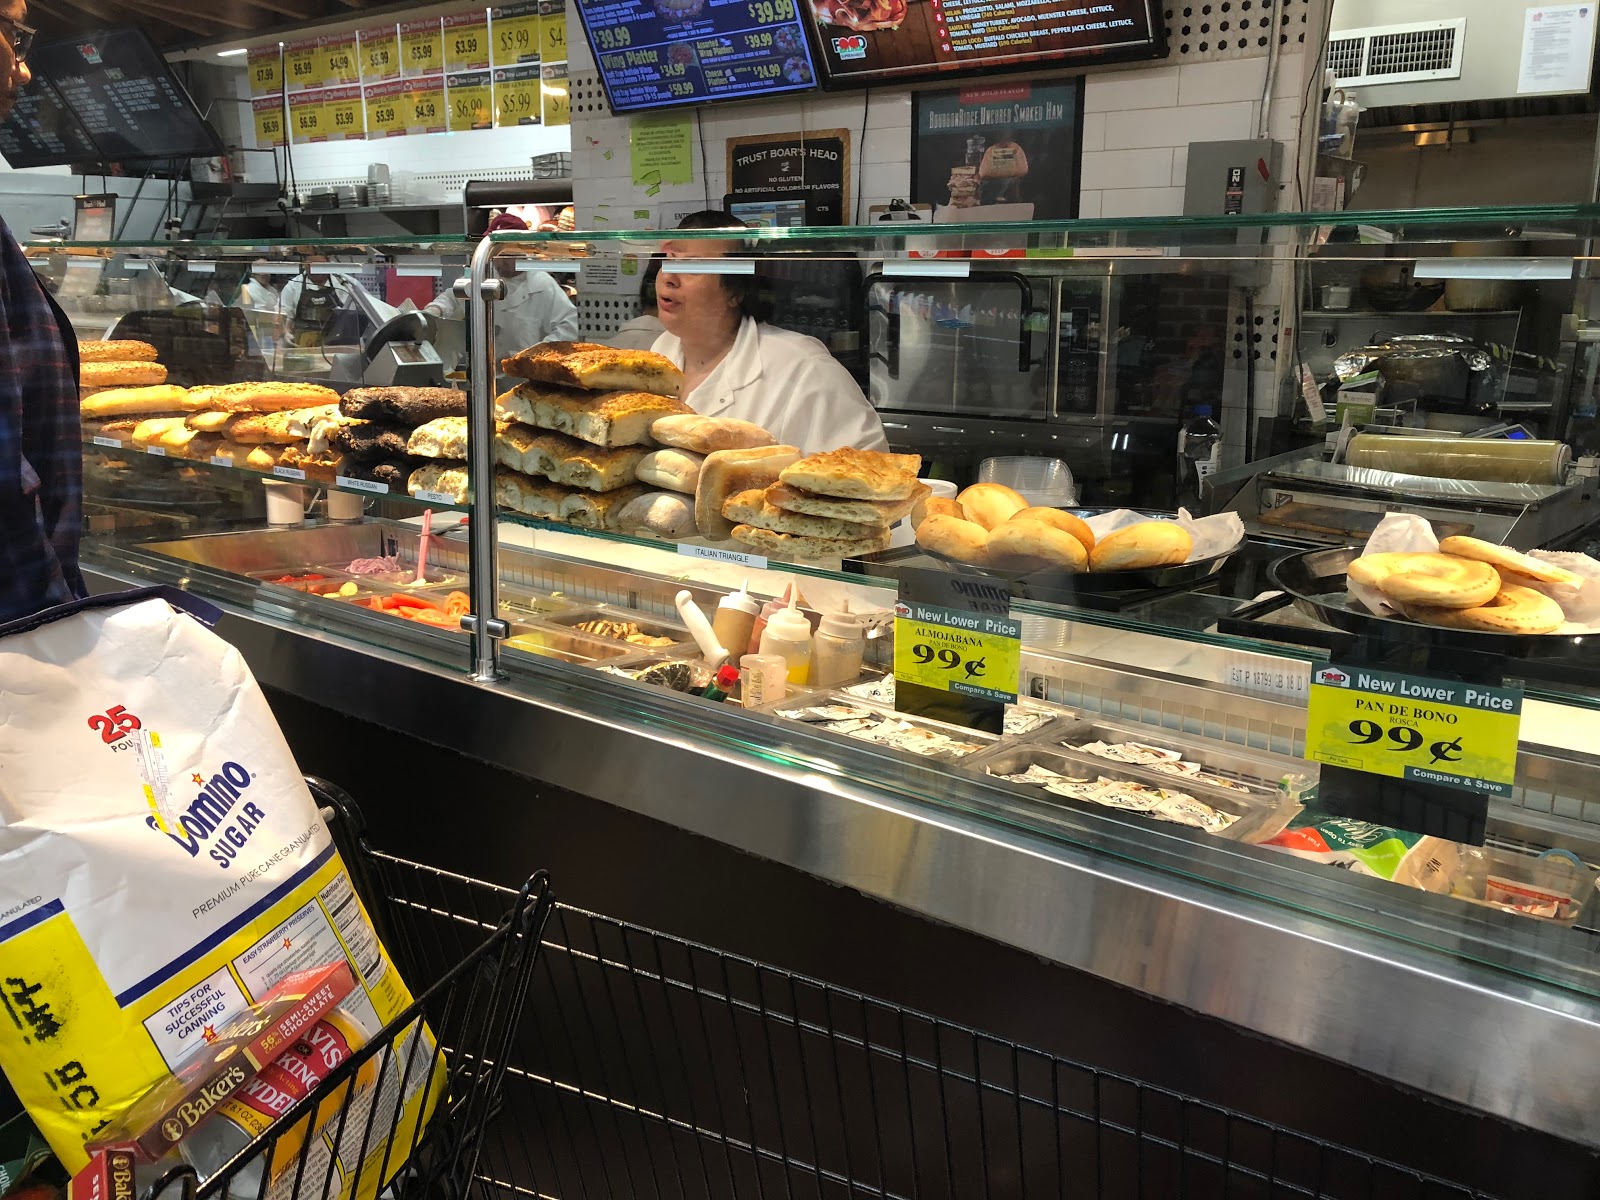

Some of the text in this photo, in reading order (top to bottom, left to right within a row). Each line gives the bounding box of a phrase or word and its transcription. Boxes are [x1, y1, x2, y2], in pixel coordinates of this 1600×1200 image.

[1011, 15, 1037, 24] AVOCADO,
[1066, 9, 1089, 17] CHEESE,
[1089, 5, 1114, 14] LETTUCE,
[593, 26, 631, 48] $39.99
[1006, 31, 1028, 39] CHICKEN
[1051, 25, 1071, 35] PEPPER
[1071, 24, 1085, 33] JACK
[1086, 22, 1108, 31] CHEESE,
[1109, 19, 1134, 27] LETTUCE,
[456, 39, 477, 55] $3.99
[501, 30, 528, 52] $5.99
[745, 33, 772, 48] $39.99
[626, 50, 658, 66] Platter
[669, 82, 694, 95] $59.99
[416, 104, 435, 118] $4.99
[503, 93, 530, 114] $5.99
[1045, 101, 1064, 120] HAM
[300, 116, 316, 129] $6.99
[336, 112, 353, 125] $3.99
[376, 109, 394, 123] $5.99
[737, 148, 838, 167] TRUST BOAR'S HEAD
[347, 479, 359, 487] WHITE
[427, 493, 442, 501] PESTO
[695, 548, 748, 563] ITALIAN TRIANGLE
[917, 608, 1016, 636] New Lower Price
[915, 627, 983, 648] ALMOJABANA
[954, 683, 985, 695] Compare
[994, 691, 1011, 701] Save
[1357, 673, 1514, 711] New Lower Price
[1355, 699, 1458, 725] PAN DE BONO
[1389, 716, 1419, 728] ROSCA
[87, 704, 142, 745] 25
[110, 739, 133, 754] POU
[1413, 768, 1503, 793] Compare & Save
[209, 801, 266, 869] SUGAR
[1320, 827, 1338, 840] Open
[191, 822, 321, 919] PREMIUM PURE CANE GRANULATED
[320, 882, 340, 901] Nutrition
[242, 950, 259, 965] EASY
[257, 925, 290, 955] STRAWBERRY
[287, 904, 316, 931] PRESERVES
[167, 983, 212, 1018] TIPS FOR
[279, 984, 331, 1031] SEMI-SWEET
[165, 989, 226, 1035] SUCCESSFUL
[178, 1001, 226, 1040] CANNING
[284, 993, 335, 1037] CHOCOLATE
[302, 1024, 344, 1070] AVIS
[276, 1052, 320, 1091] KING
[177, 1065, 245, 1128] Baker's
